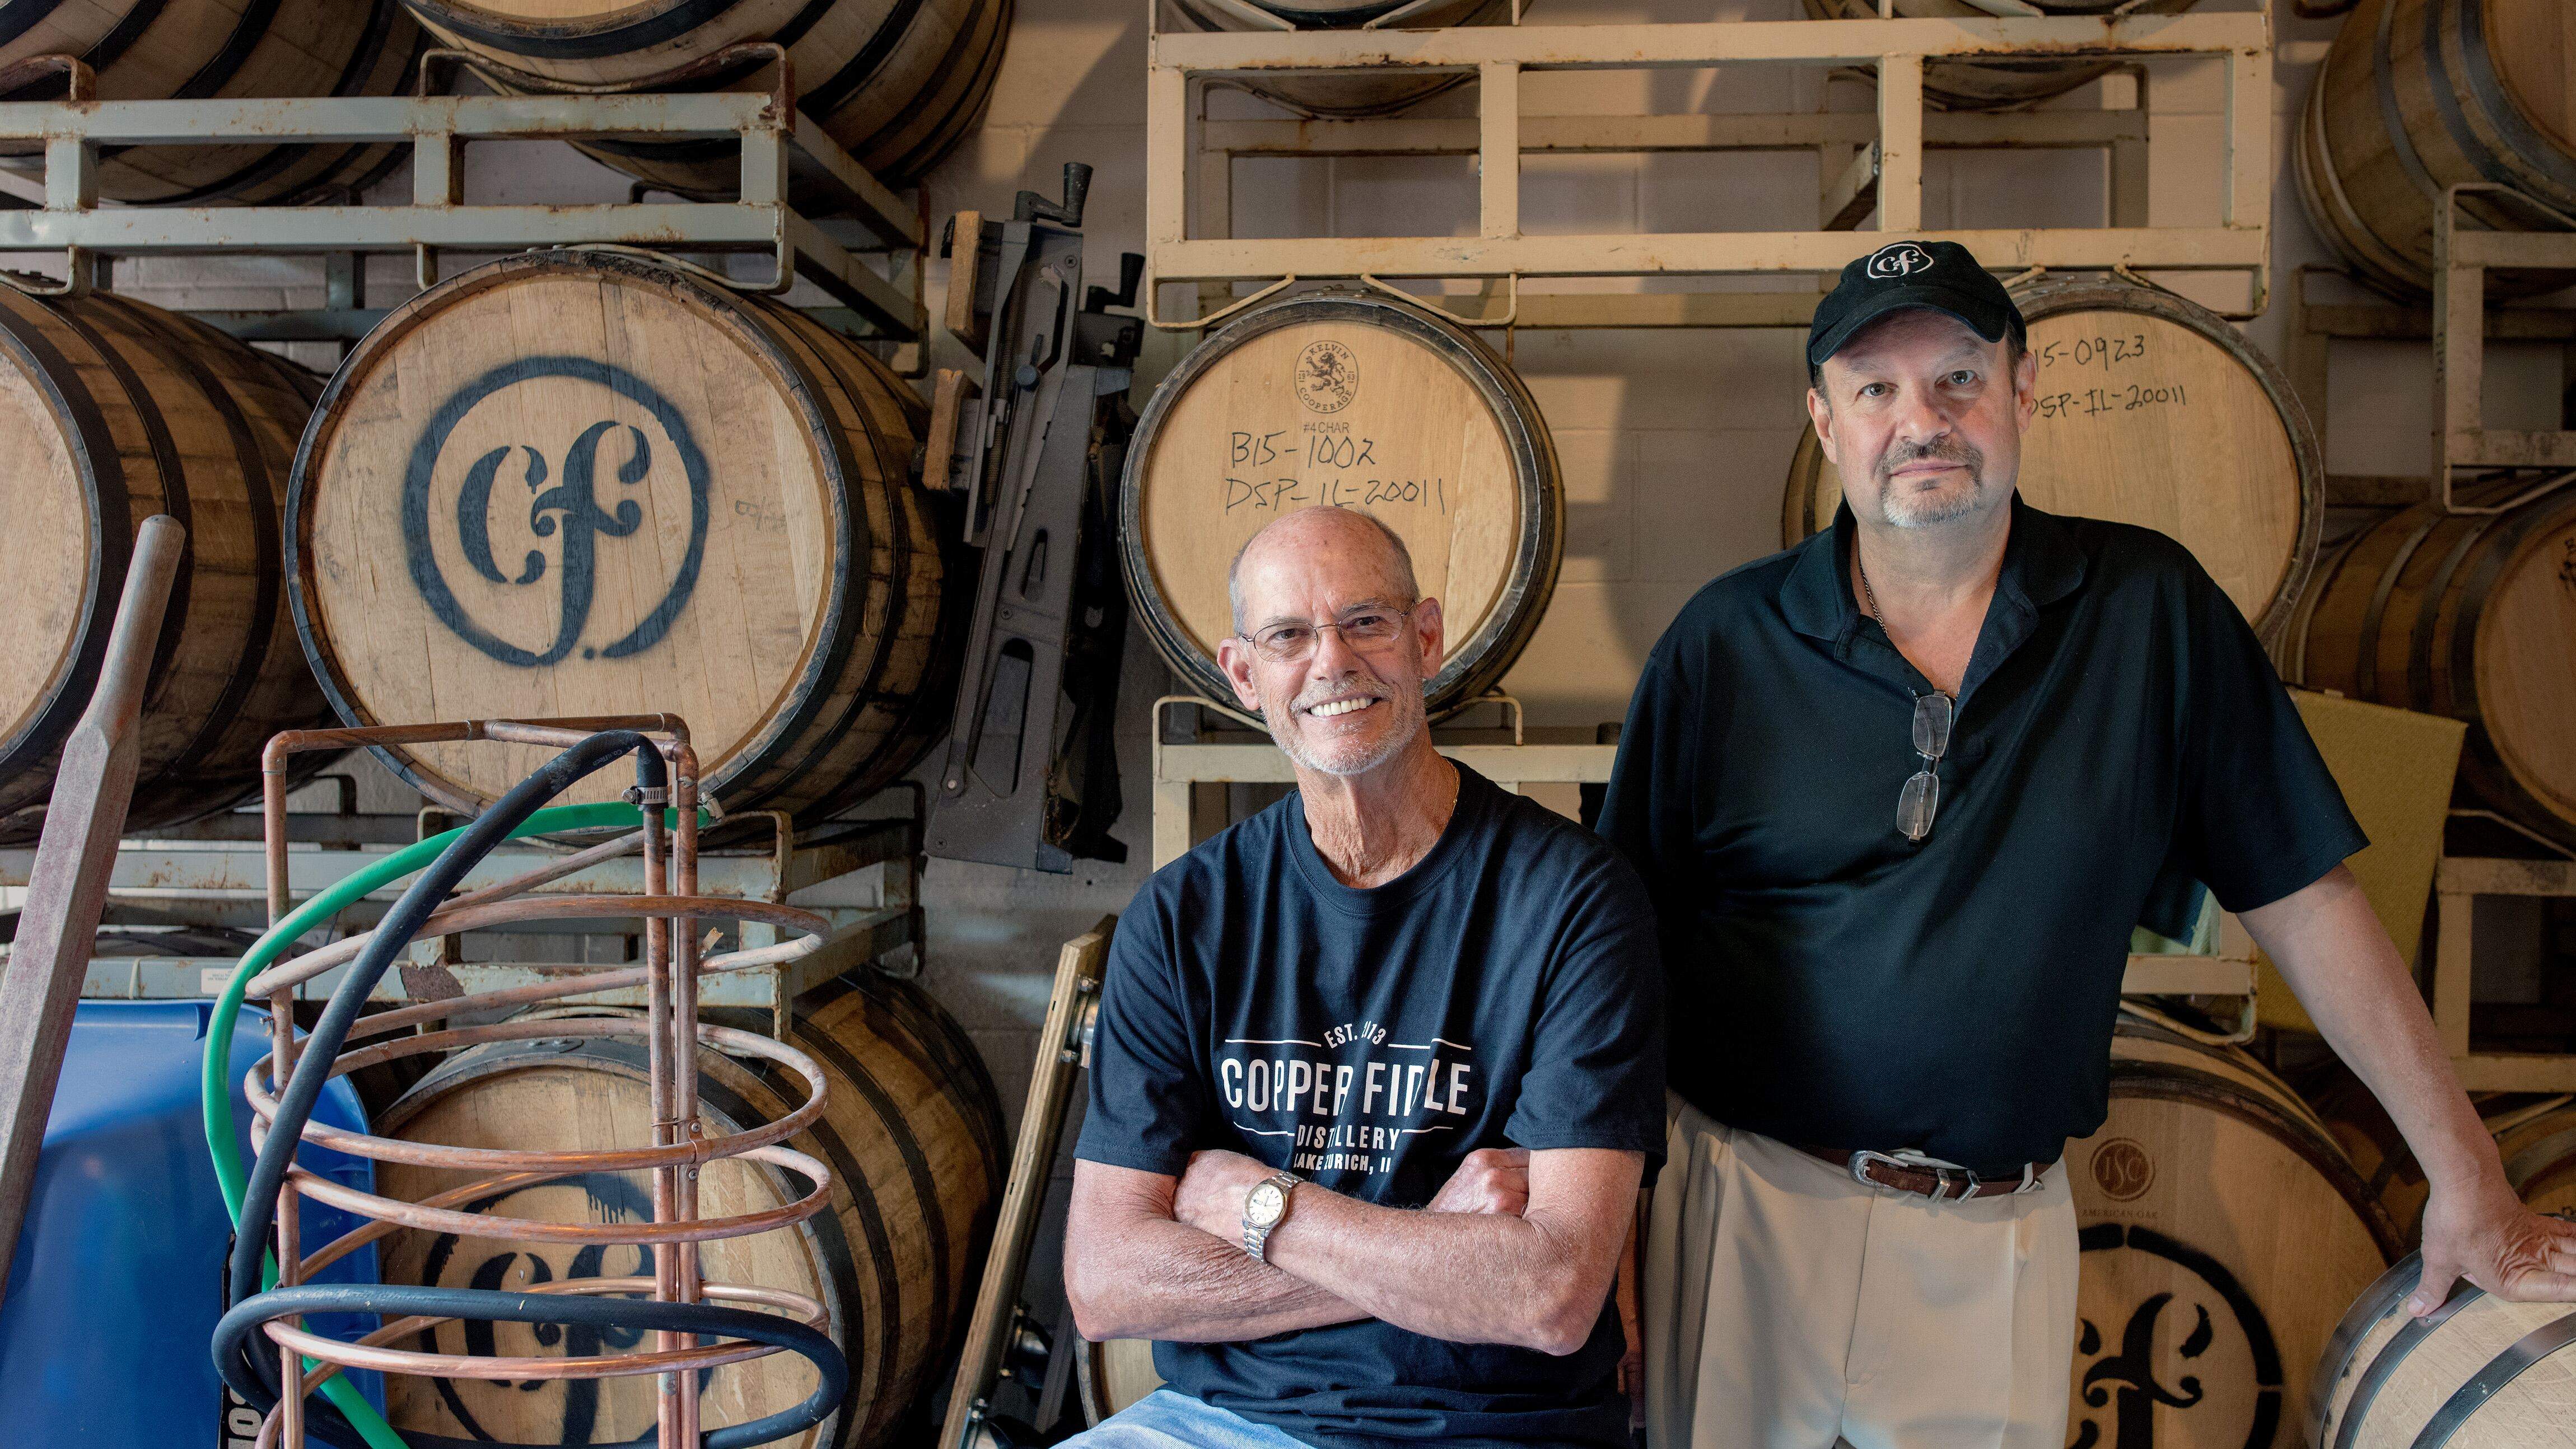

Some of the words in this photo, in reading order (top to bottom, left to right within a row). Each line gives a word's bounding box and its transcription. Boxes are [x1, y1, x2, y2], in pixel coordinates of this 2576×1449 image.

[1309, 344, 1349, 359] KELVIN
[1300, 387, 1352, 410] COOPERAGE
[1232, 431, 1376, 469] B15-1002
[1324, 1023, 1357, 1049] EST.
[1221, 1058, 1354, 1116] COPPER
[1296, 1124, 1400, 1150] DISTILLERY
[1294, 1153, 1324, 1170] LAKE
